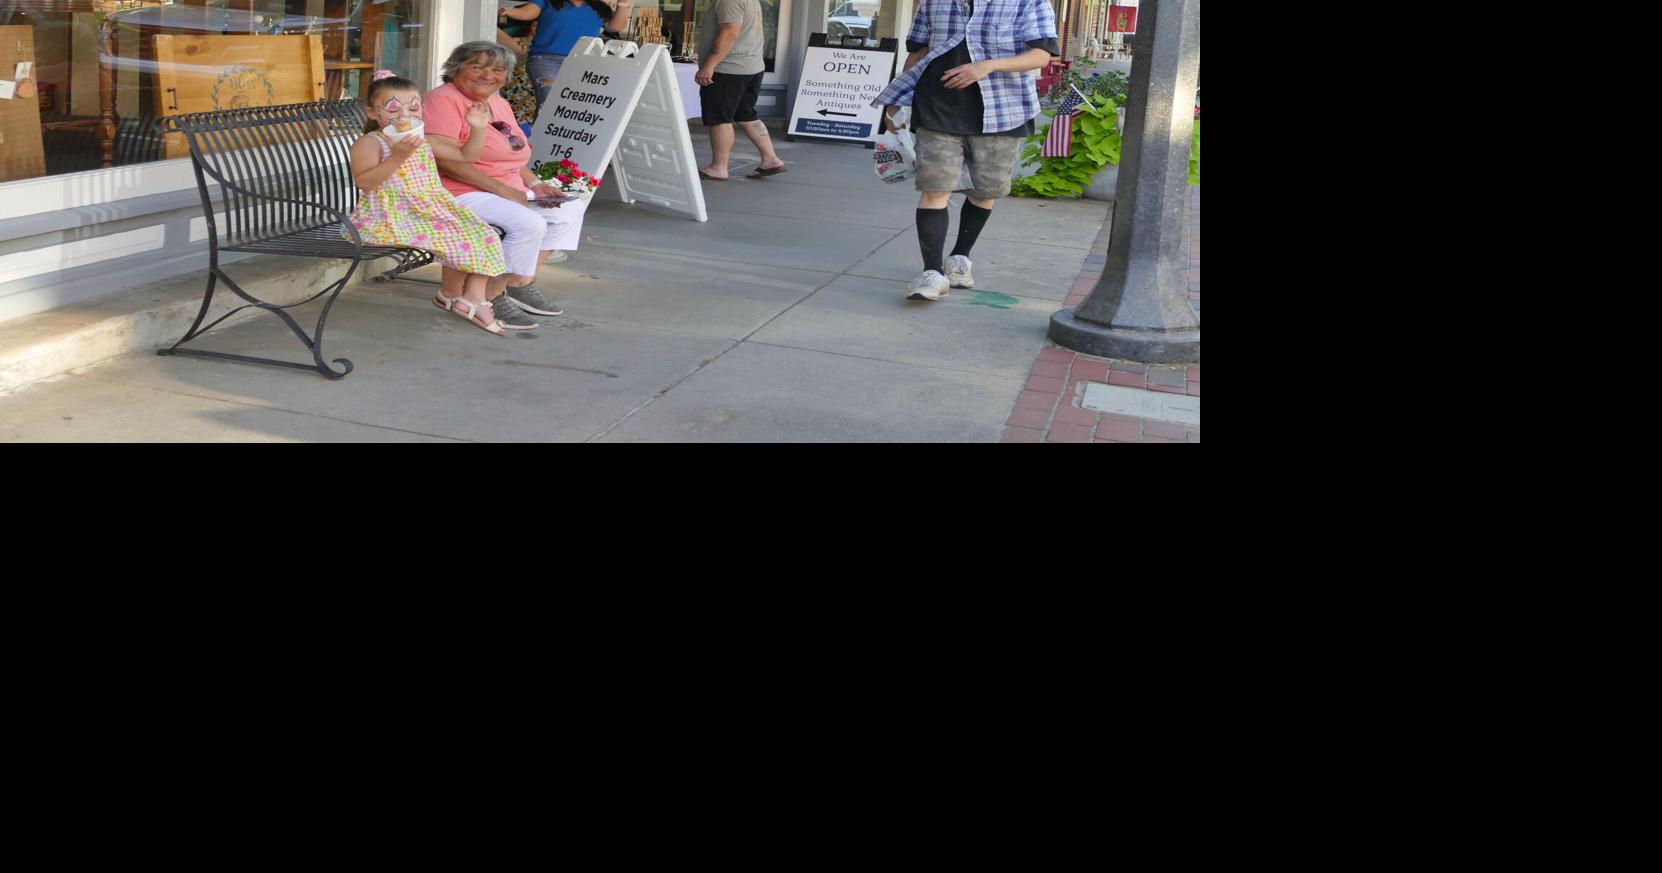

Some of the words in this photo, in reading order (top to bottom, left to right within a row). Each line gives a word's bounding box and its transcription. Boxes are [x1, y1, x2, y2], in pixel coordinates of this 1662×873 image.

[832, 51, 847, 59] We
[823, 61, 872, 75] OPEN
[581, 70, 609, 86] Mars
[805, 79, 860, 92] Something
[863, 83, 881, 92] Old
[560, 87, 616, 109] Creamery
[800, 88, 856, 101] Something
[815, 99, 862, 110] Antiques
[554, 105, 604, 126] Monday-
[545, 123, 598, 145] Saturday
[550, 143, 574, 159] 11-6
